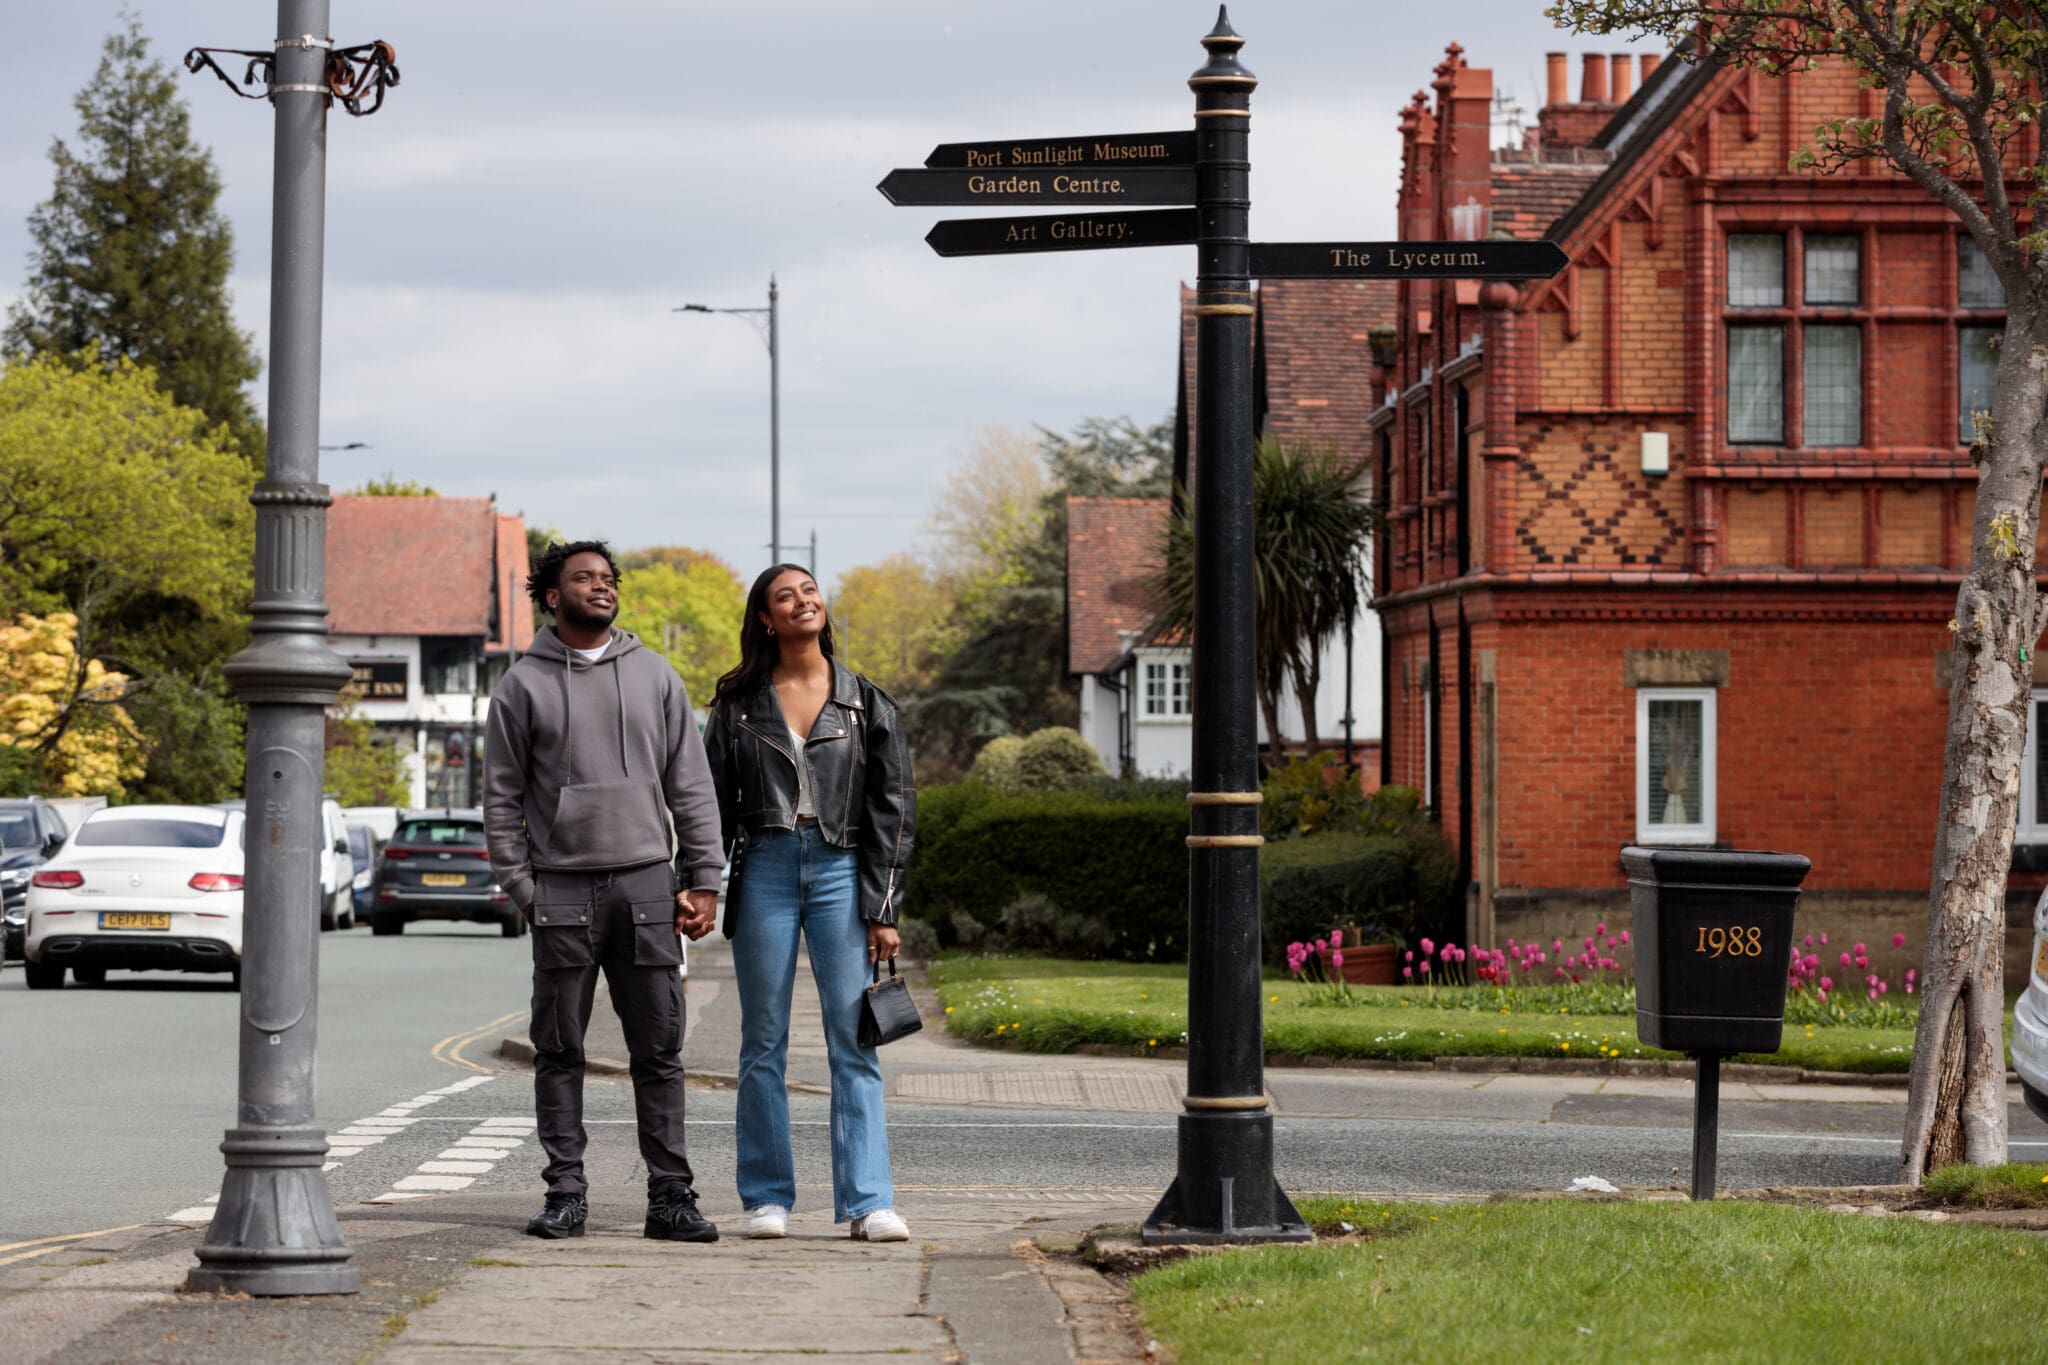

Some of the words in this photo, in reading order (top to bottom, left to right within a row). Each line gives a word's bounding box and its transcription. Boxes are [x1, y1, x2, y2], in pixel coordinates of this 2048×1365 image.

[966, 149, 1002, 167] Port
[1012, 146, 1083, 165] Sunlight
[1093, 142, 1170, 161] Museum.
[968, 176, 1041, 193] Garden
[1053, 175, 1125, 193] Centre.
[1006, 224, 1037, 241] Art
[1051, 220, 1134, 240] Gallery.
[1330, 249, 1371, 267] The
[1388, 249, 1486, 269] Lyceum.
[374, 682, 404, 695] INN
[1695, 926, 1762, 959] 1988
